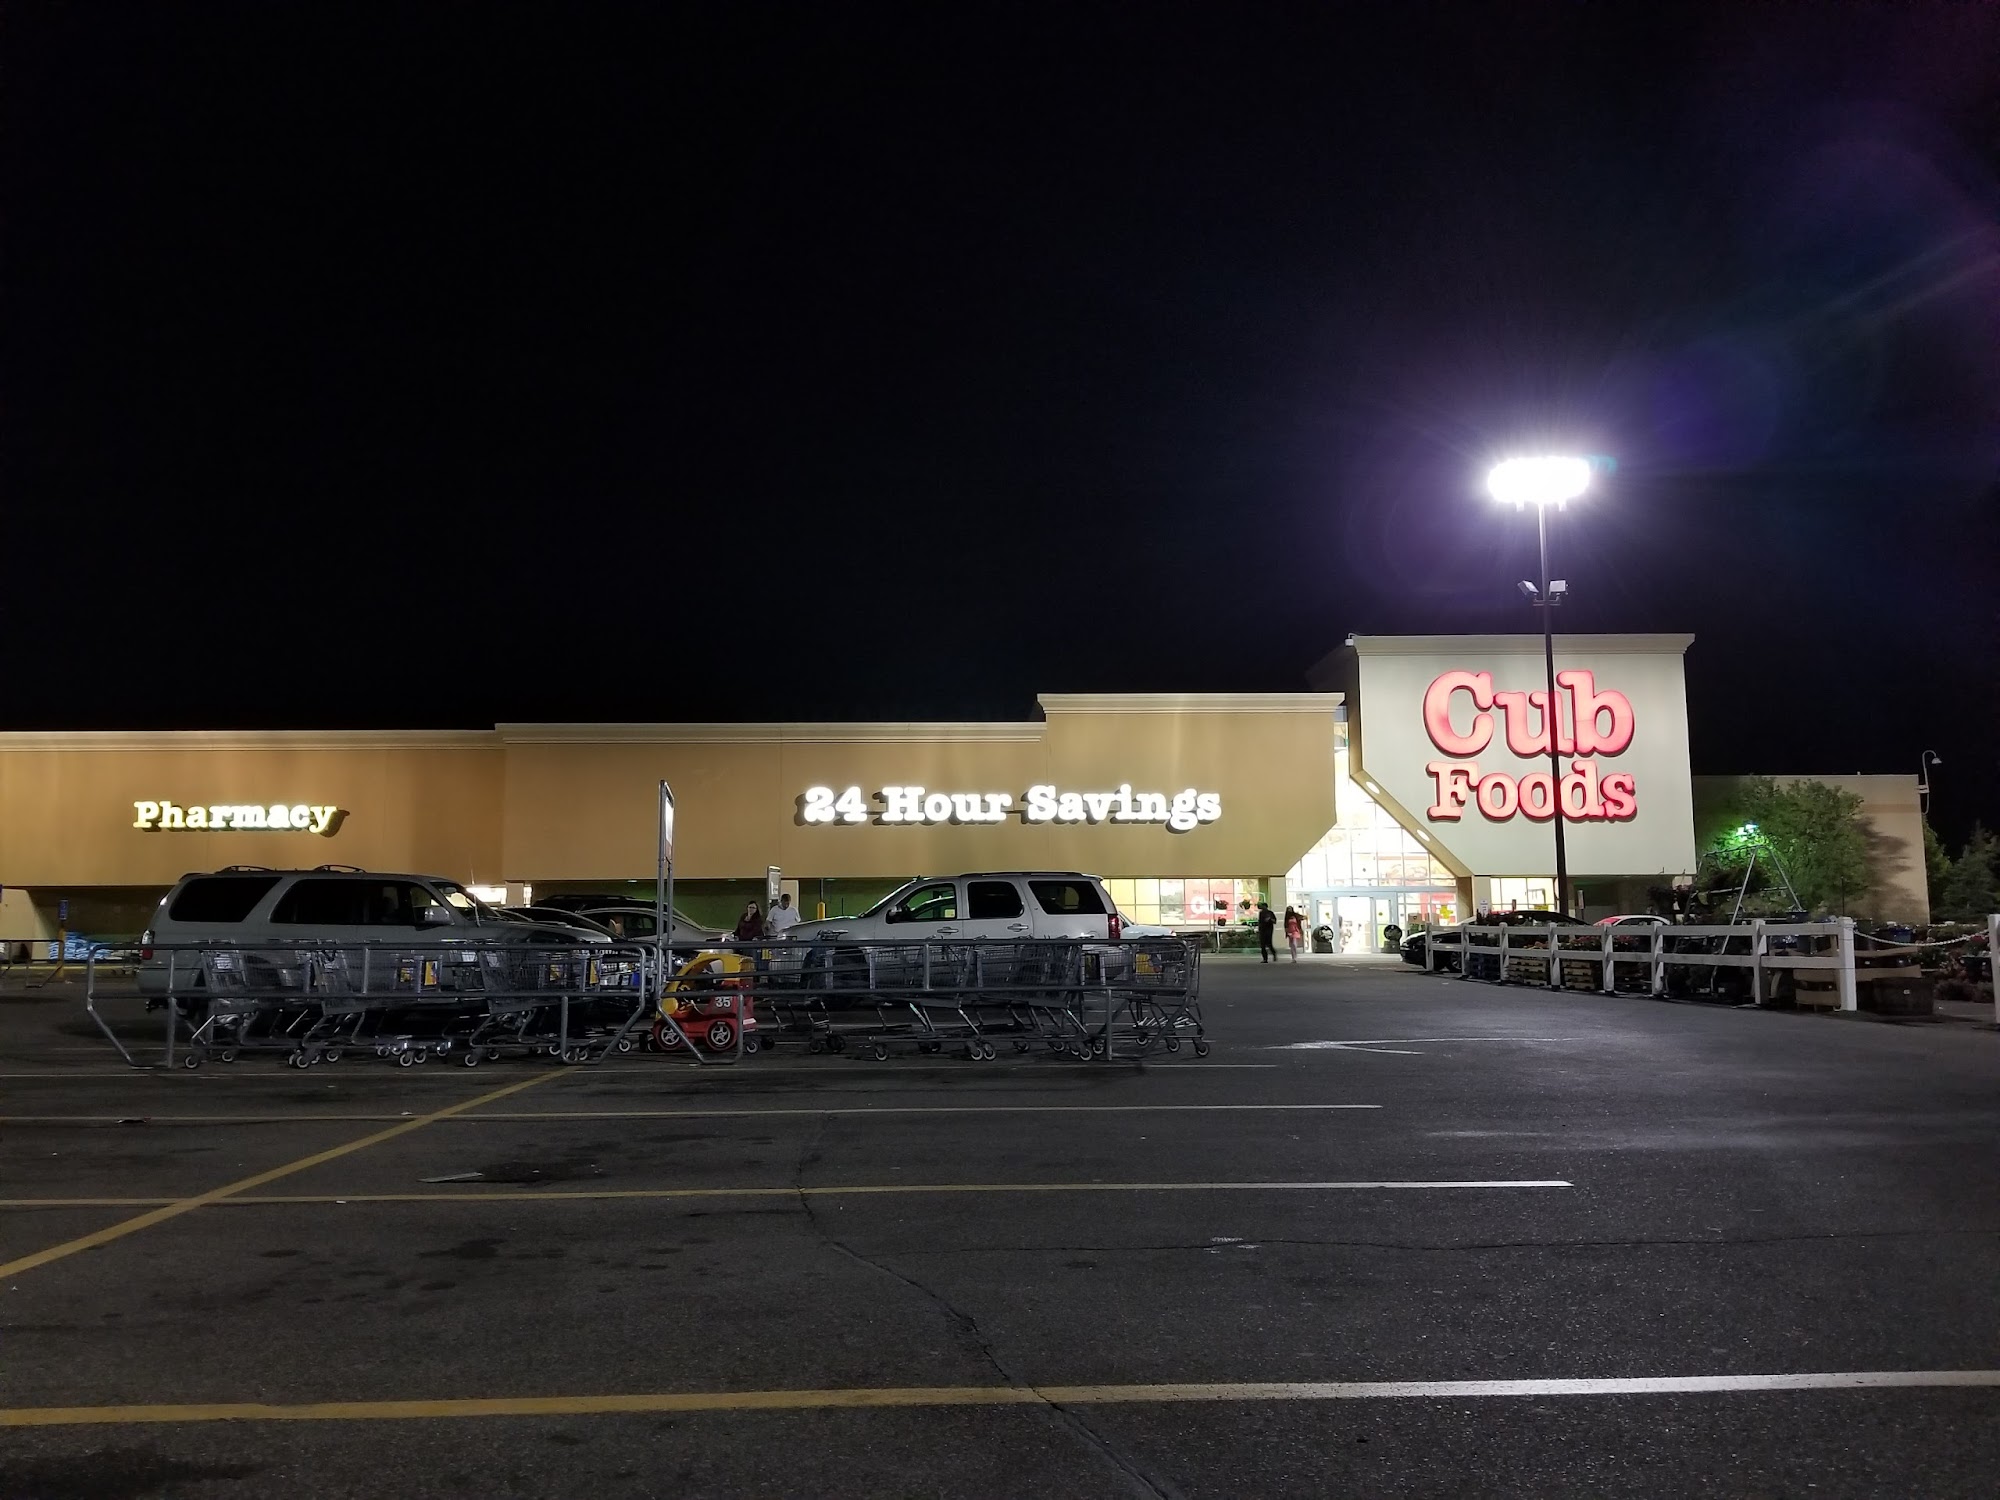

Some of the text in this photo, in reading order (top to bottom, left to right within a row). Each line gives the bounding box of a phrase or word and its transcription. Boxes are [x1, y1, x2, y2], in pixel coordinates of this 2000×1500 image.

[1423, 670, 1635, 758] Cub
[804, 783, 1222, 831] 24 Hour Savings
[1425, 760, 1637, 822] Foods
[133, 801, 337, 833] Pharmacy
[715, 997, 731, 1008] 35
